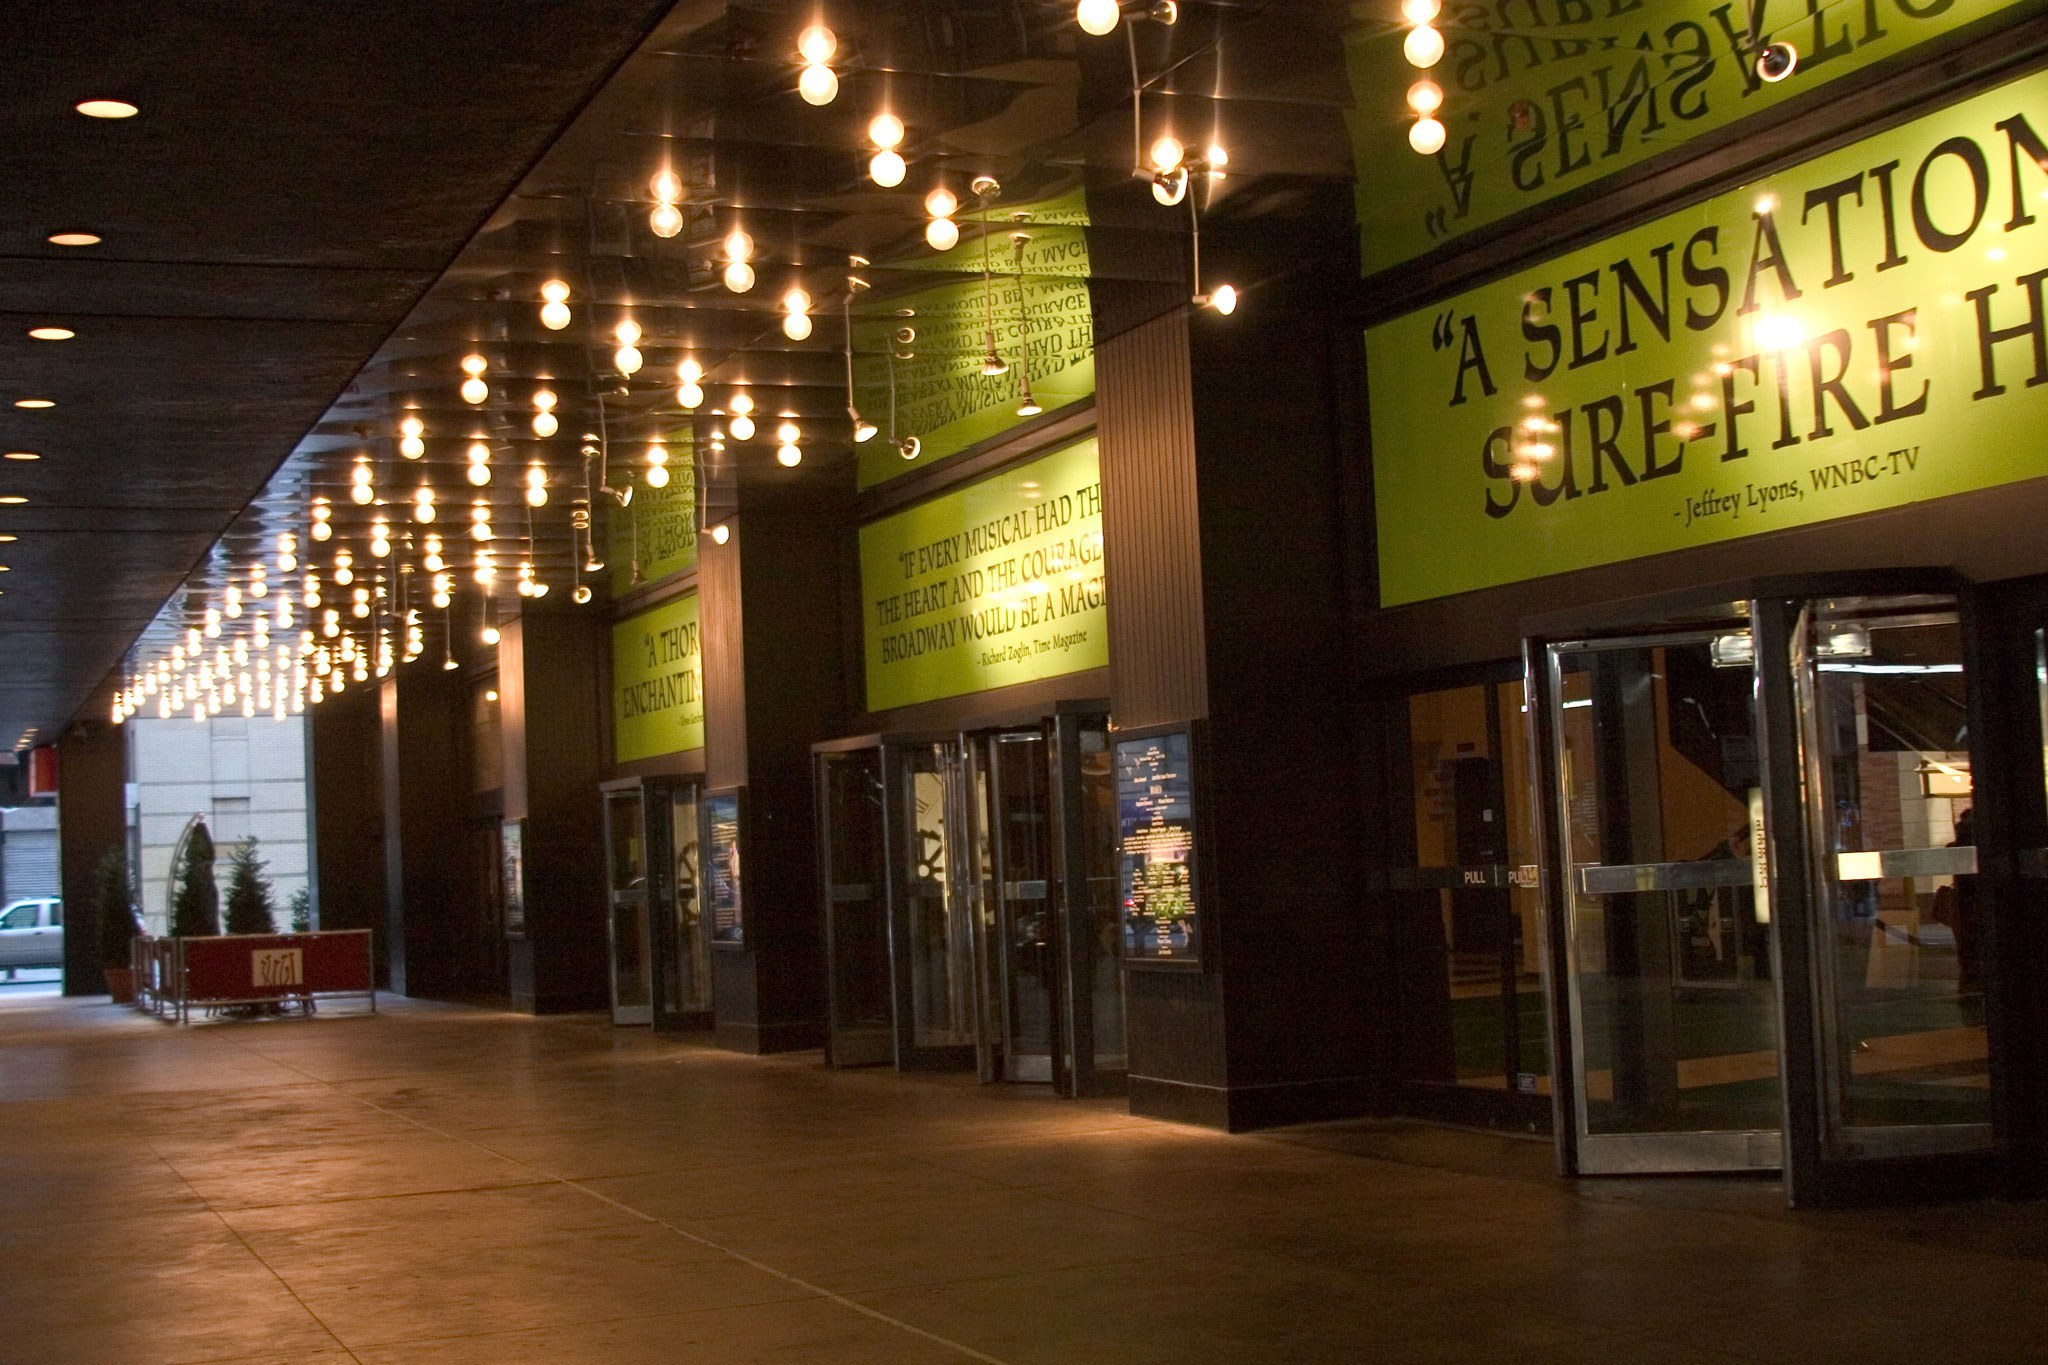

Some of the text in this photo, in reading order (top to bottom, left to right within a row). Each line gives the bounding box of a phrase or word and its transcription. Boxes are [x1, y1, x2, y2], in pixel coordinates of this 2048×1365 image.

[1482, 307, 1931, 519] SURE-FIRE
[1686, 489, 1741, 527] Jeffrey
[1746, 479, 1804, 513] Lyons,
[1809, 446, 1920, 493] WNBC-TV
[918, 535, 961, 575] EVERY
[964, 510, 1032, 559] MUSICAL
[1036, 494, 1072, 535] HAD
[877, 531, 1102, 627] THE HEART AND THE COURAGE
[882, 619, 958, 664] BROADWAY
[960, 603, 1016, 643] WOULD
[1021, 596, 1040, 629] BE
[1044, 591, 1056, 622] A
[982, 646, 1006, 667] Richard
[1008, 641, 1032, 664] Zoglin,
[1033, 634, 1051, 654] Time
[1053, 630, 1088, 652] Magazine
[1464, 871, 1486, 884] PULL
